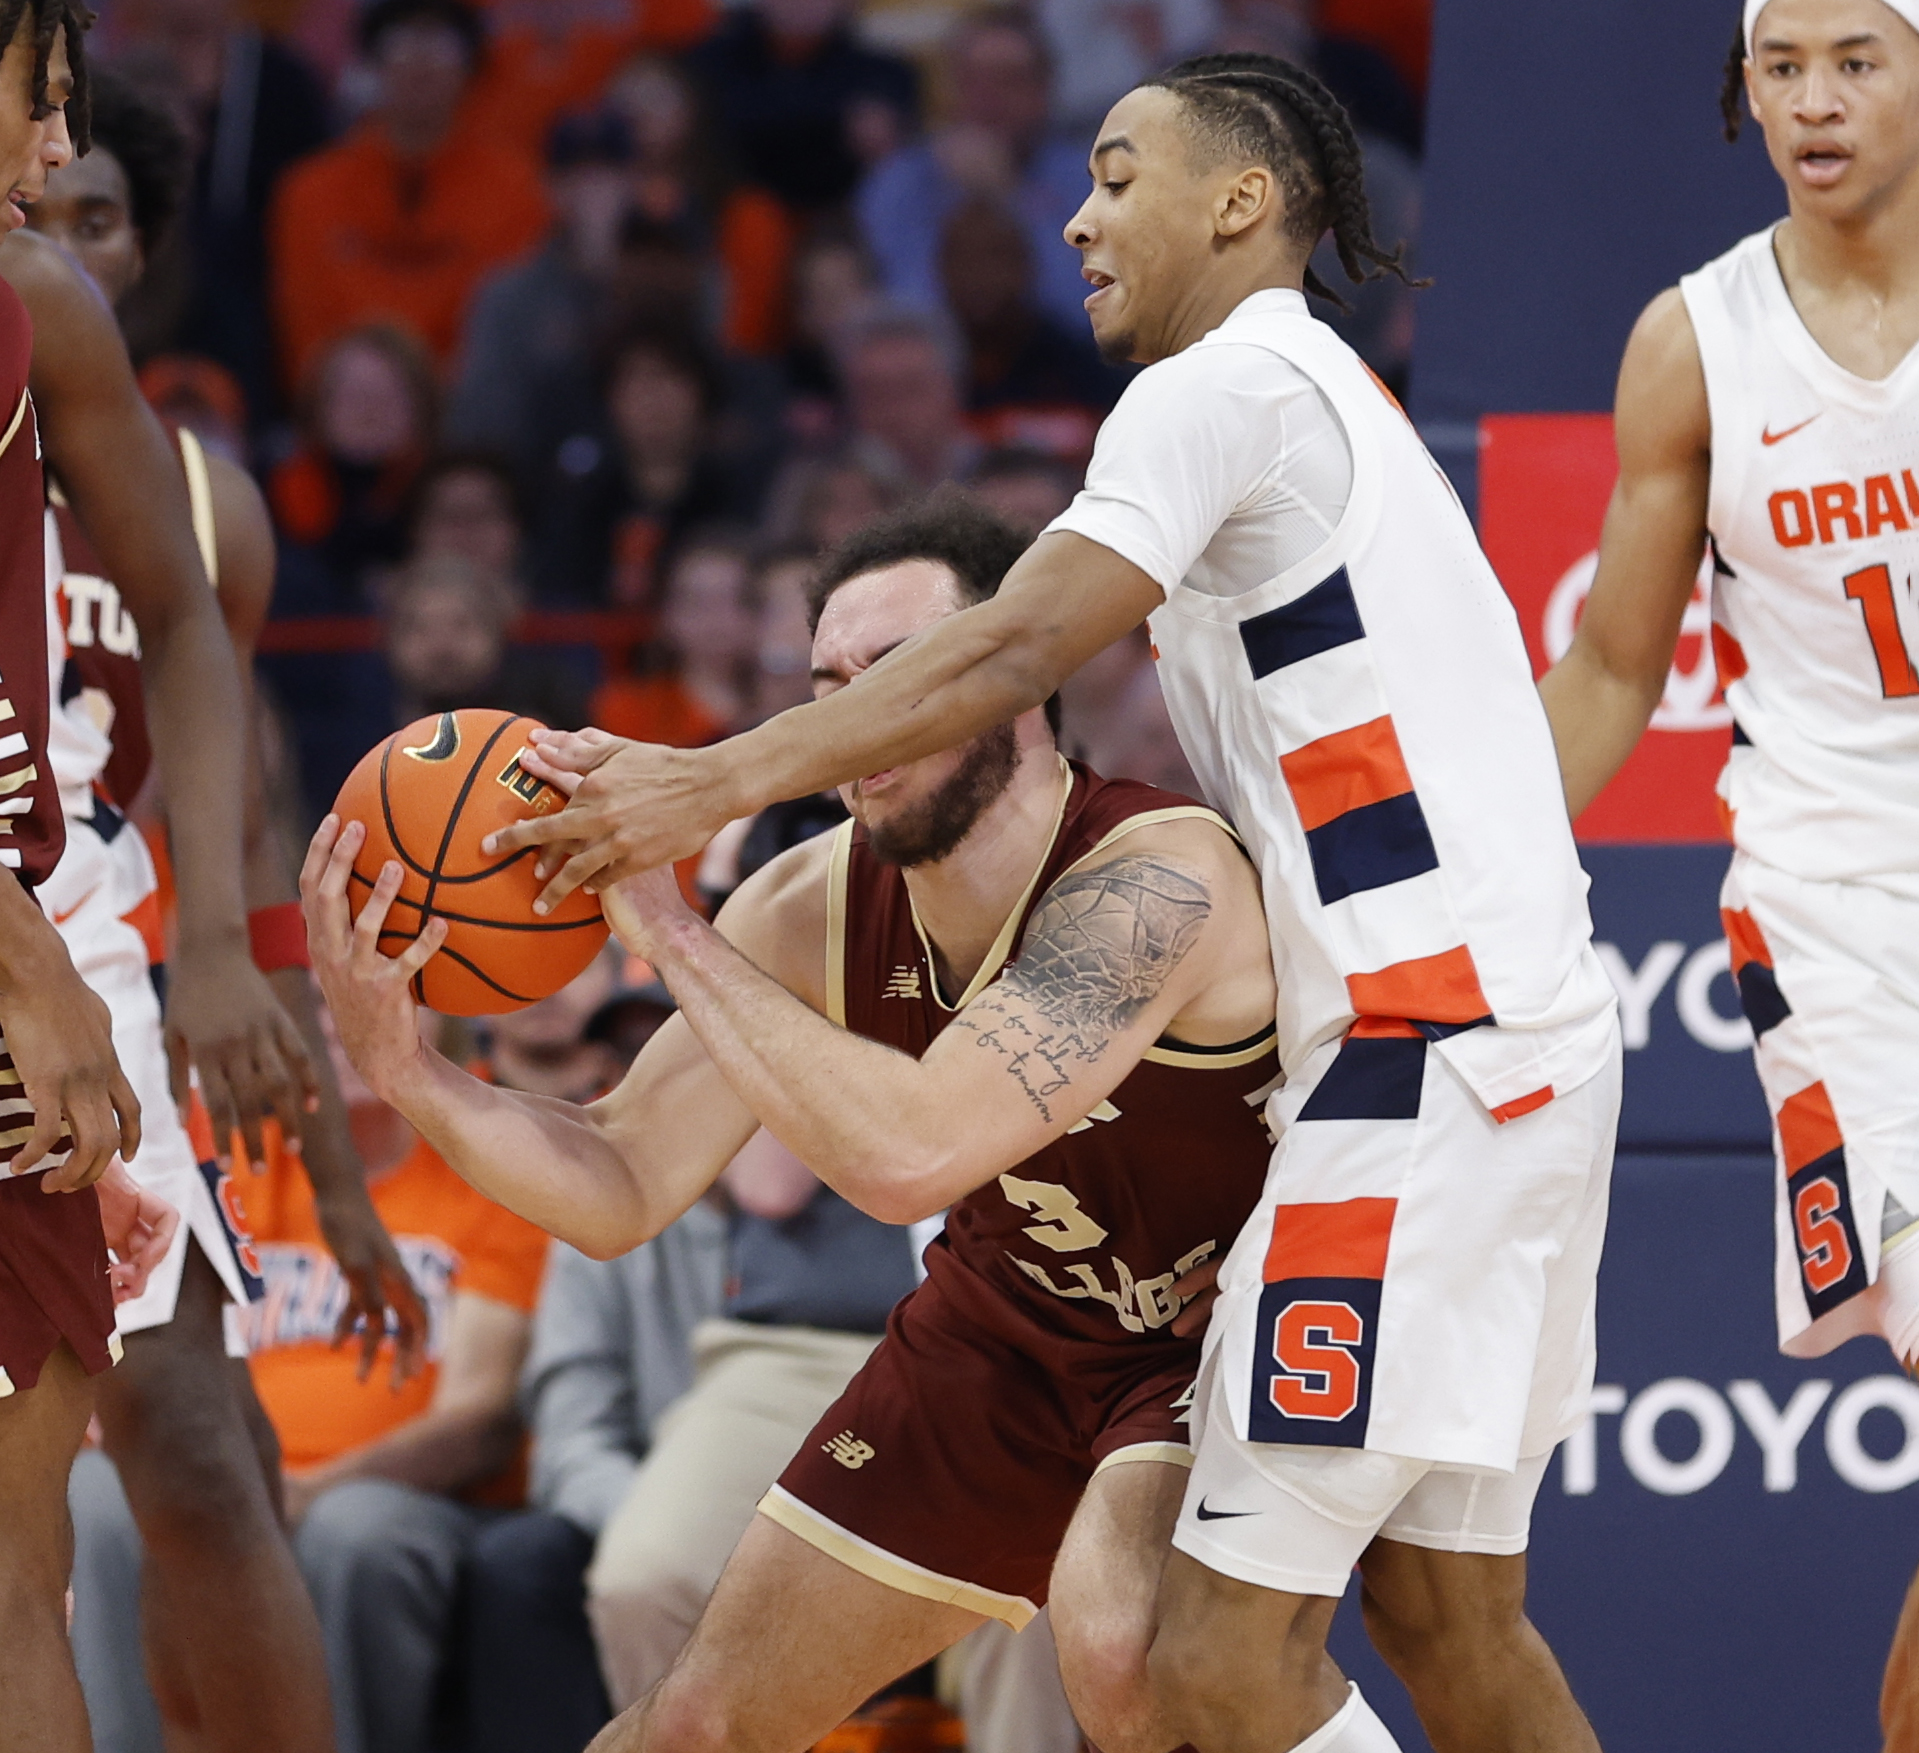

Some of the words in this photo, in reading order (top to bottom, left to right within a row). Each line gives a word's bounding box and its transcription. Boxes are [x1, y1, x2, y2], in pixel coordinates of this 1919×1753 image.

[1842, 562, 1919, 699] 1
[1007, 1050, 1053, 1123] tomorrow
[1034, 1033, 1071, 1095] today
[1056, 1033, 1109, 1063] past
[1793, 1176, 1852, 1295] S
[1270, 1300, 1364, 1423] S
